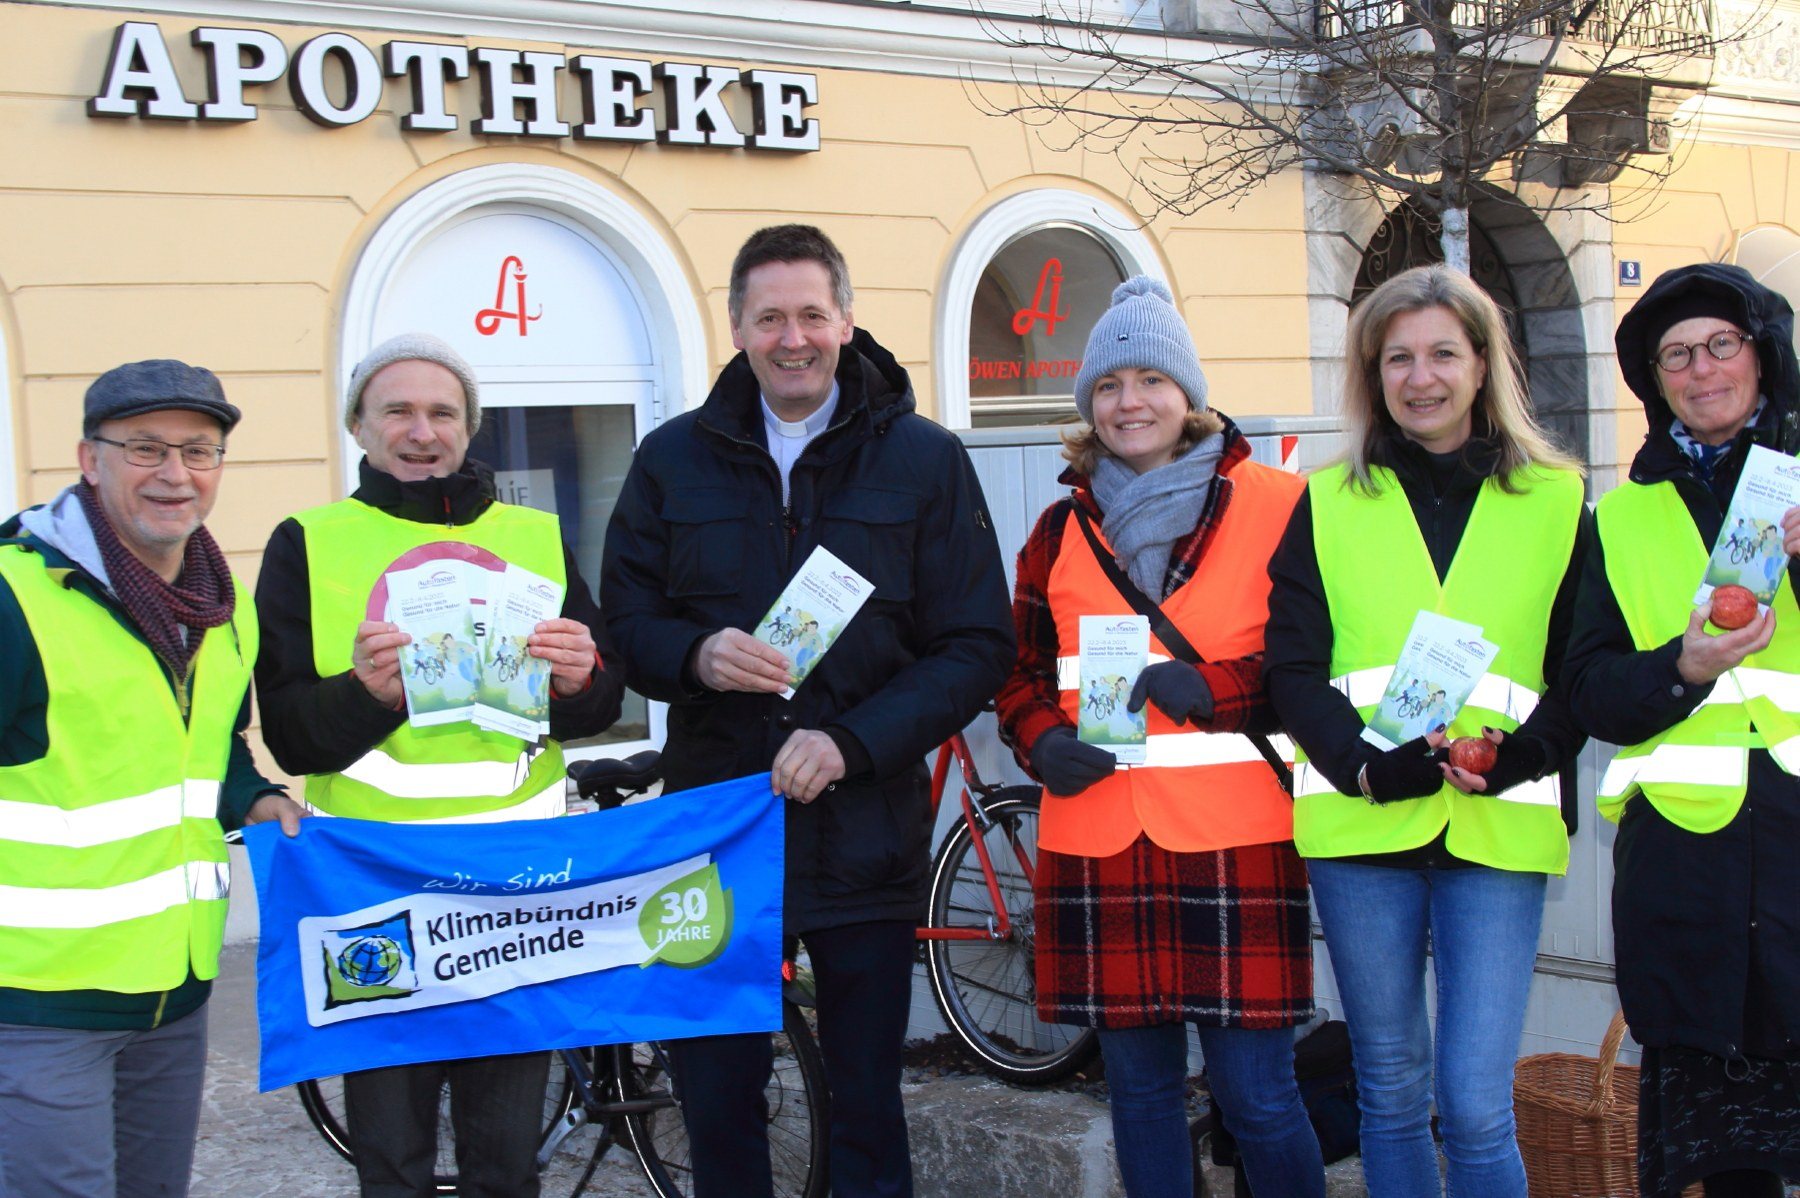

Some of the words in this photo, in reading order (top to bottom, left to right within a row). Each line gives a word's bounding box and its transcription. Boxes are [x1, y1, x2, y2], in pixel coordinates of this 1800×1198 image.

[89, 21, 821, 152] APOTHEKE
[1627, 262, 1635, 278] 8
[968, 357, 1024, 379] ÖWEN
[1025, 360, 1085, 379] APOTH
[502, 857, 573, 891] sind
[426, 894, 637, 946] Klimabündnis
[659, 887, 708, 925] 30
[656, 925, 711, 944] JAHRE
[434, 926, 584, 981] Gemeinde
